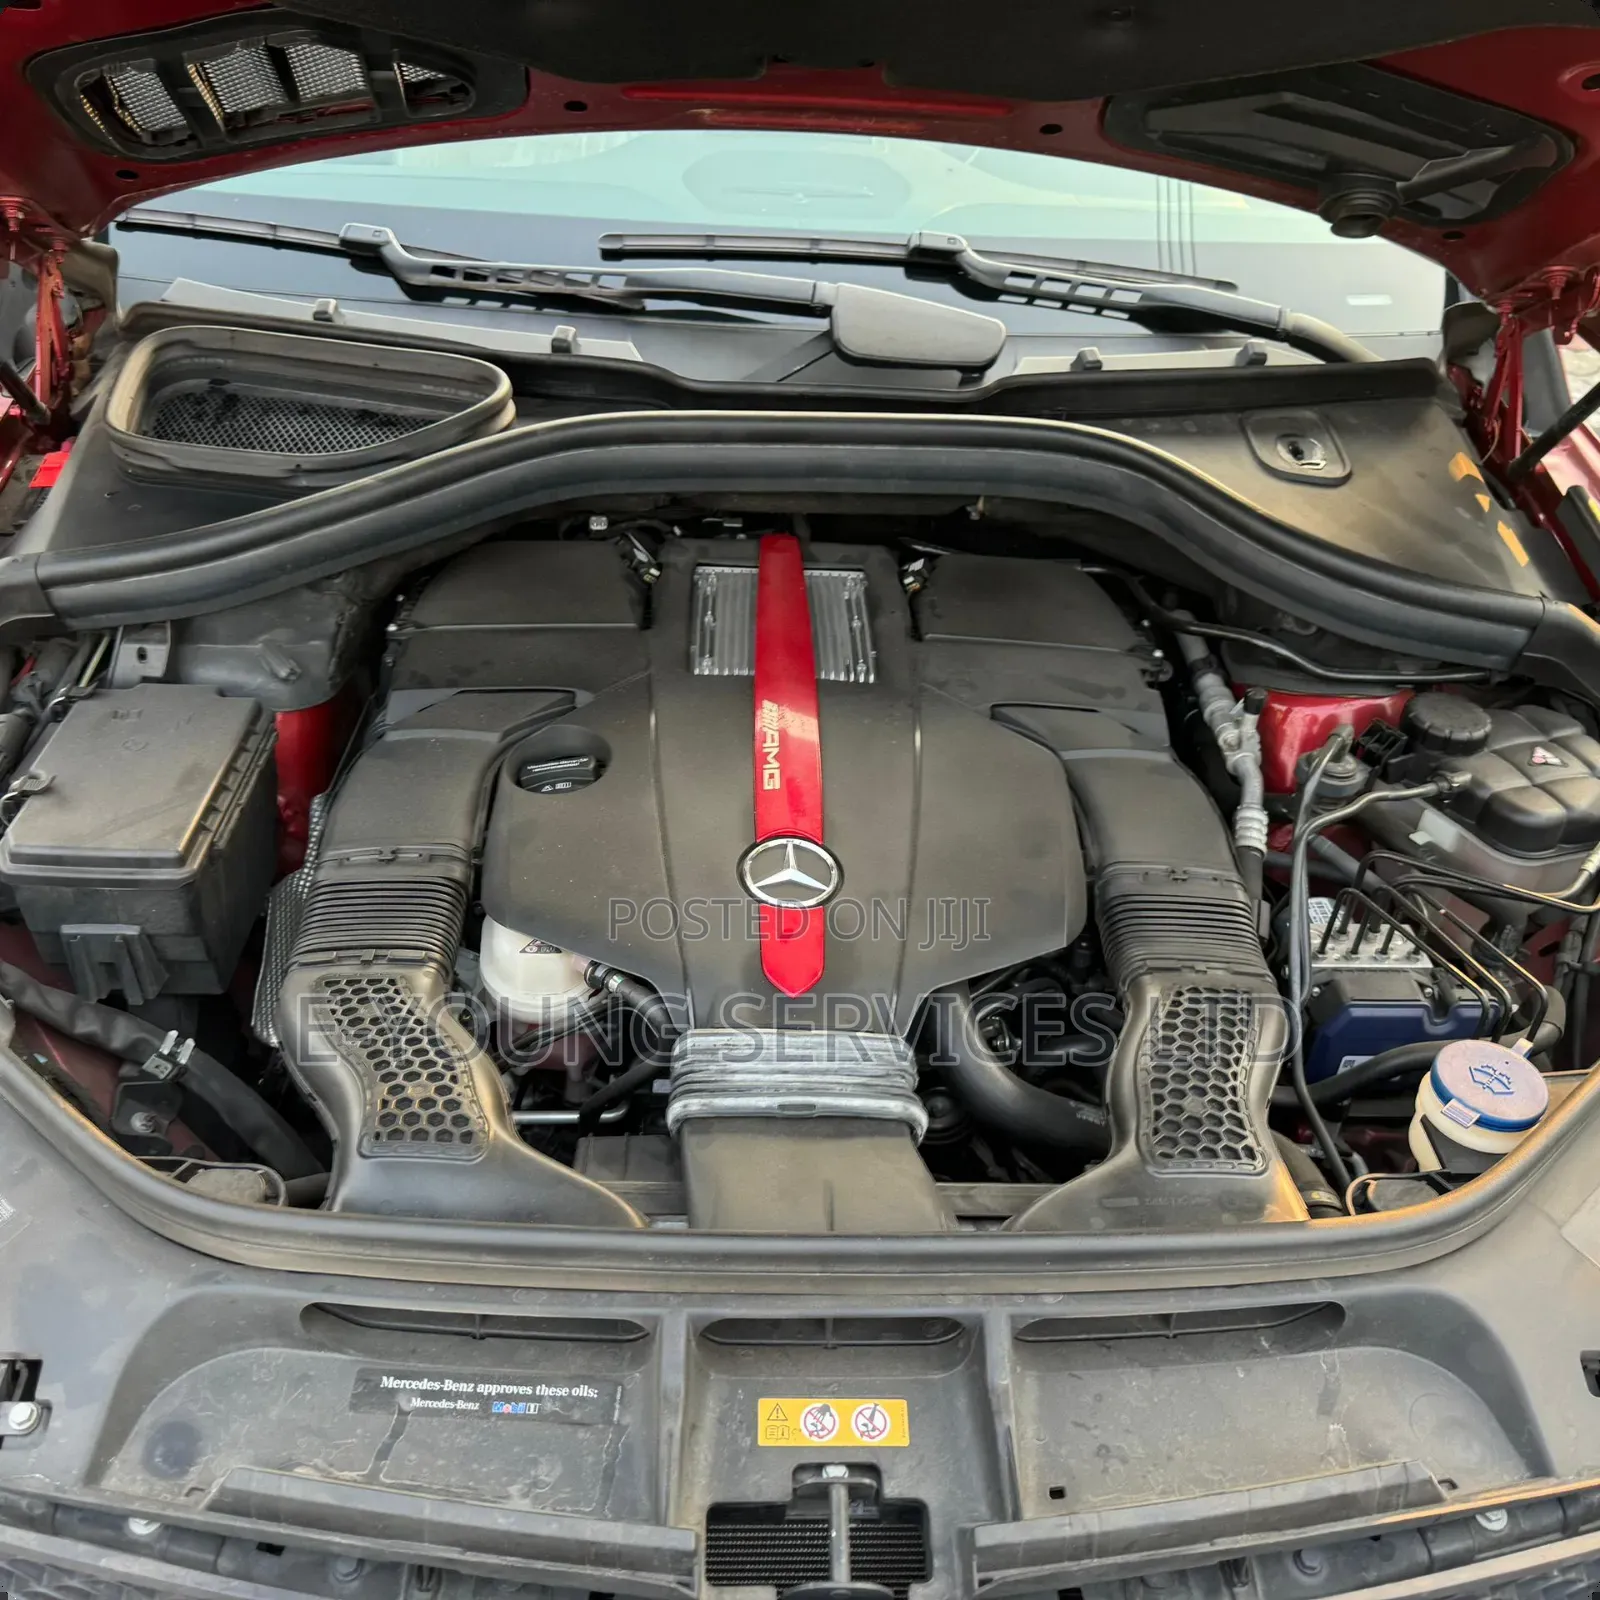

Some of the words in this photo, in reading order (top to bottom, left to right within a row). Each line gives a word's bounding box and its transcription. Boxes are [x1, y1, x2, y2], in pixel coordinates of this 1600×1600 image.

[380, 1375, 475, 1393] Mercedes-Benz
[476, 1382, 534, 1396] approves
[535, 1384, 570, 1397] these
[571, 1384, 600, 1399] oils:
[410, 1396, 481, 1411] Mercedes-Benz
[491, 1400, 527, 1414] Mobil
